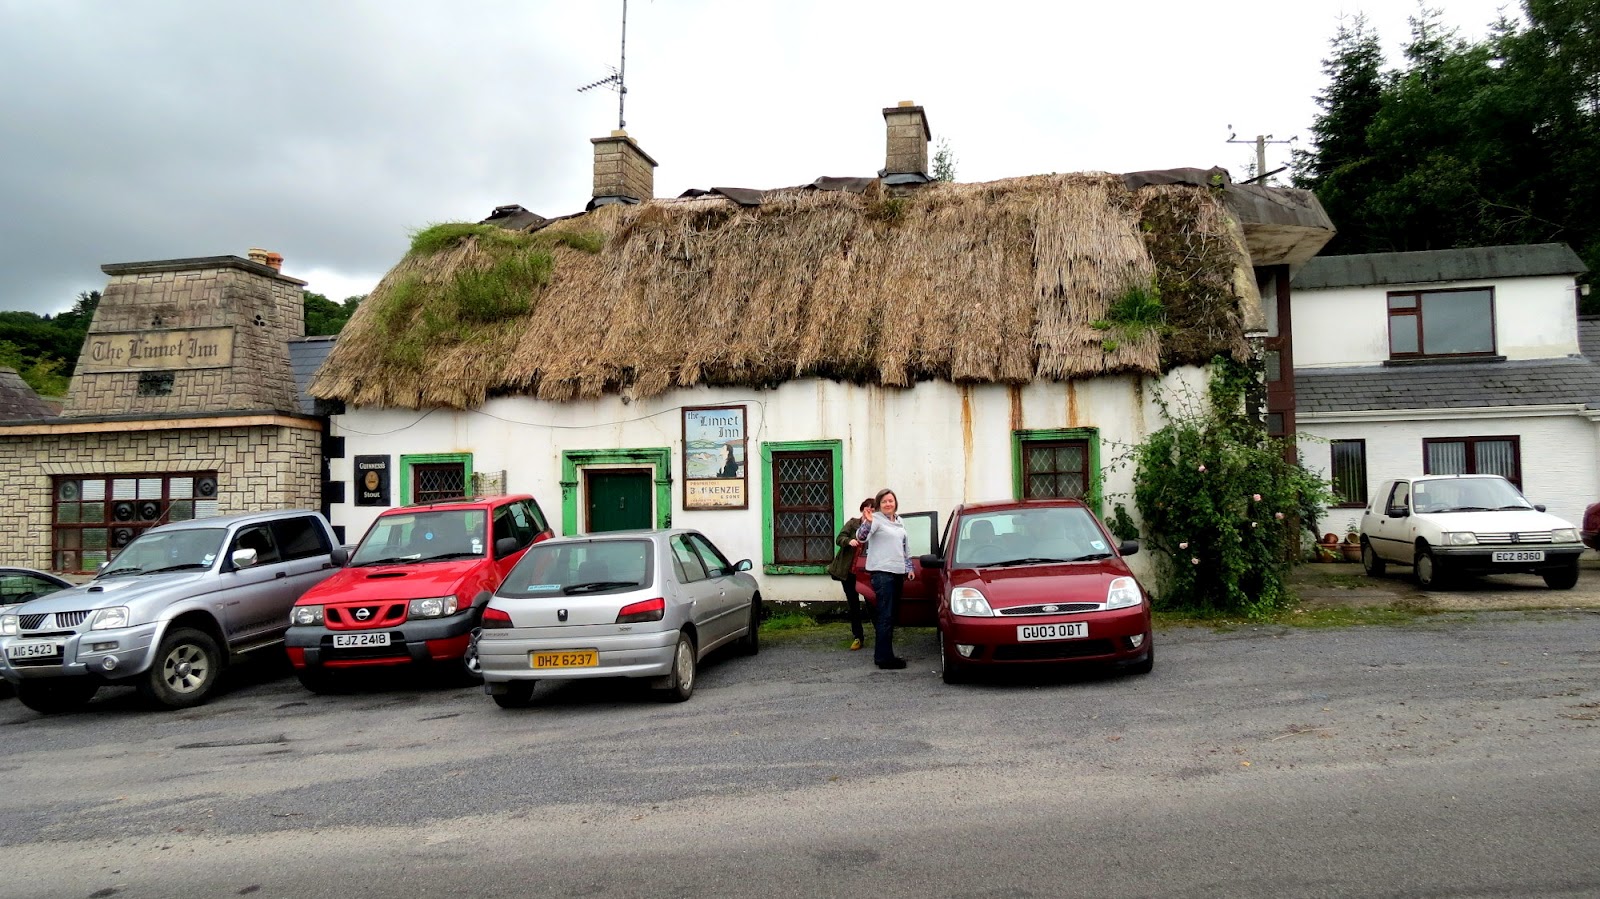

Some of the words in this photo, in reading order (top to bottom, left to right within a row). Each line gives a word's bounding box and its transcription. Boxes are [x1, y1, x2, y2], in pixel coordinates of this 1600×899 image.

[92, 341, 123, 365] The
[128, 339, 184, 366] Linnet
[186, 338, 218, 364] Inn
[700, 416, 738, 426] Linnet
[719, 427, 739, 437] Inn
[1496, 552, 1515, 561] ECZ
[1517, 552, 1541, 561] 8360
[1023, 625, 1056, 639] GU03
[337, 635, 358, 646] EJZ
[360, 633, 386, 645] 2418
[13, 646, 26, 657] AIG
[28, 644, 52, 656] 5423
[537, 655, 559, 667] DHZ
[562, 653, 593, 666] 6237
